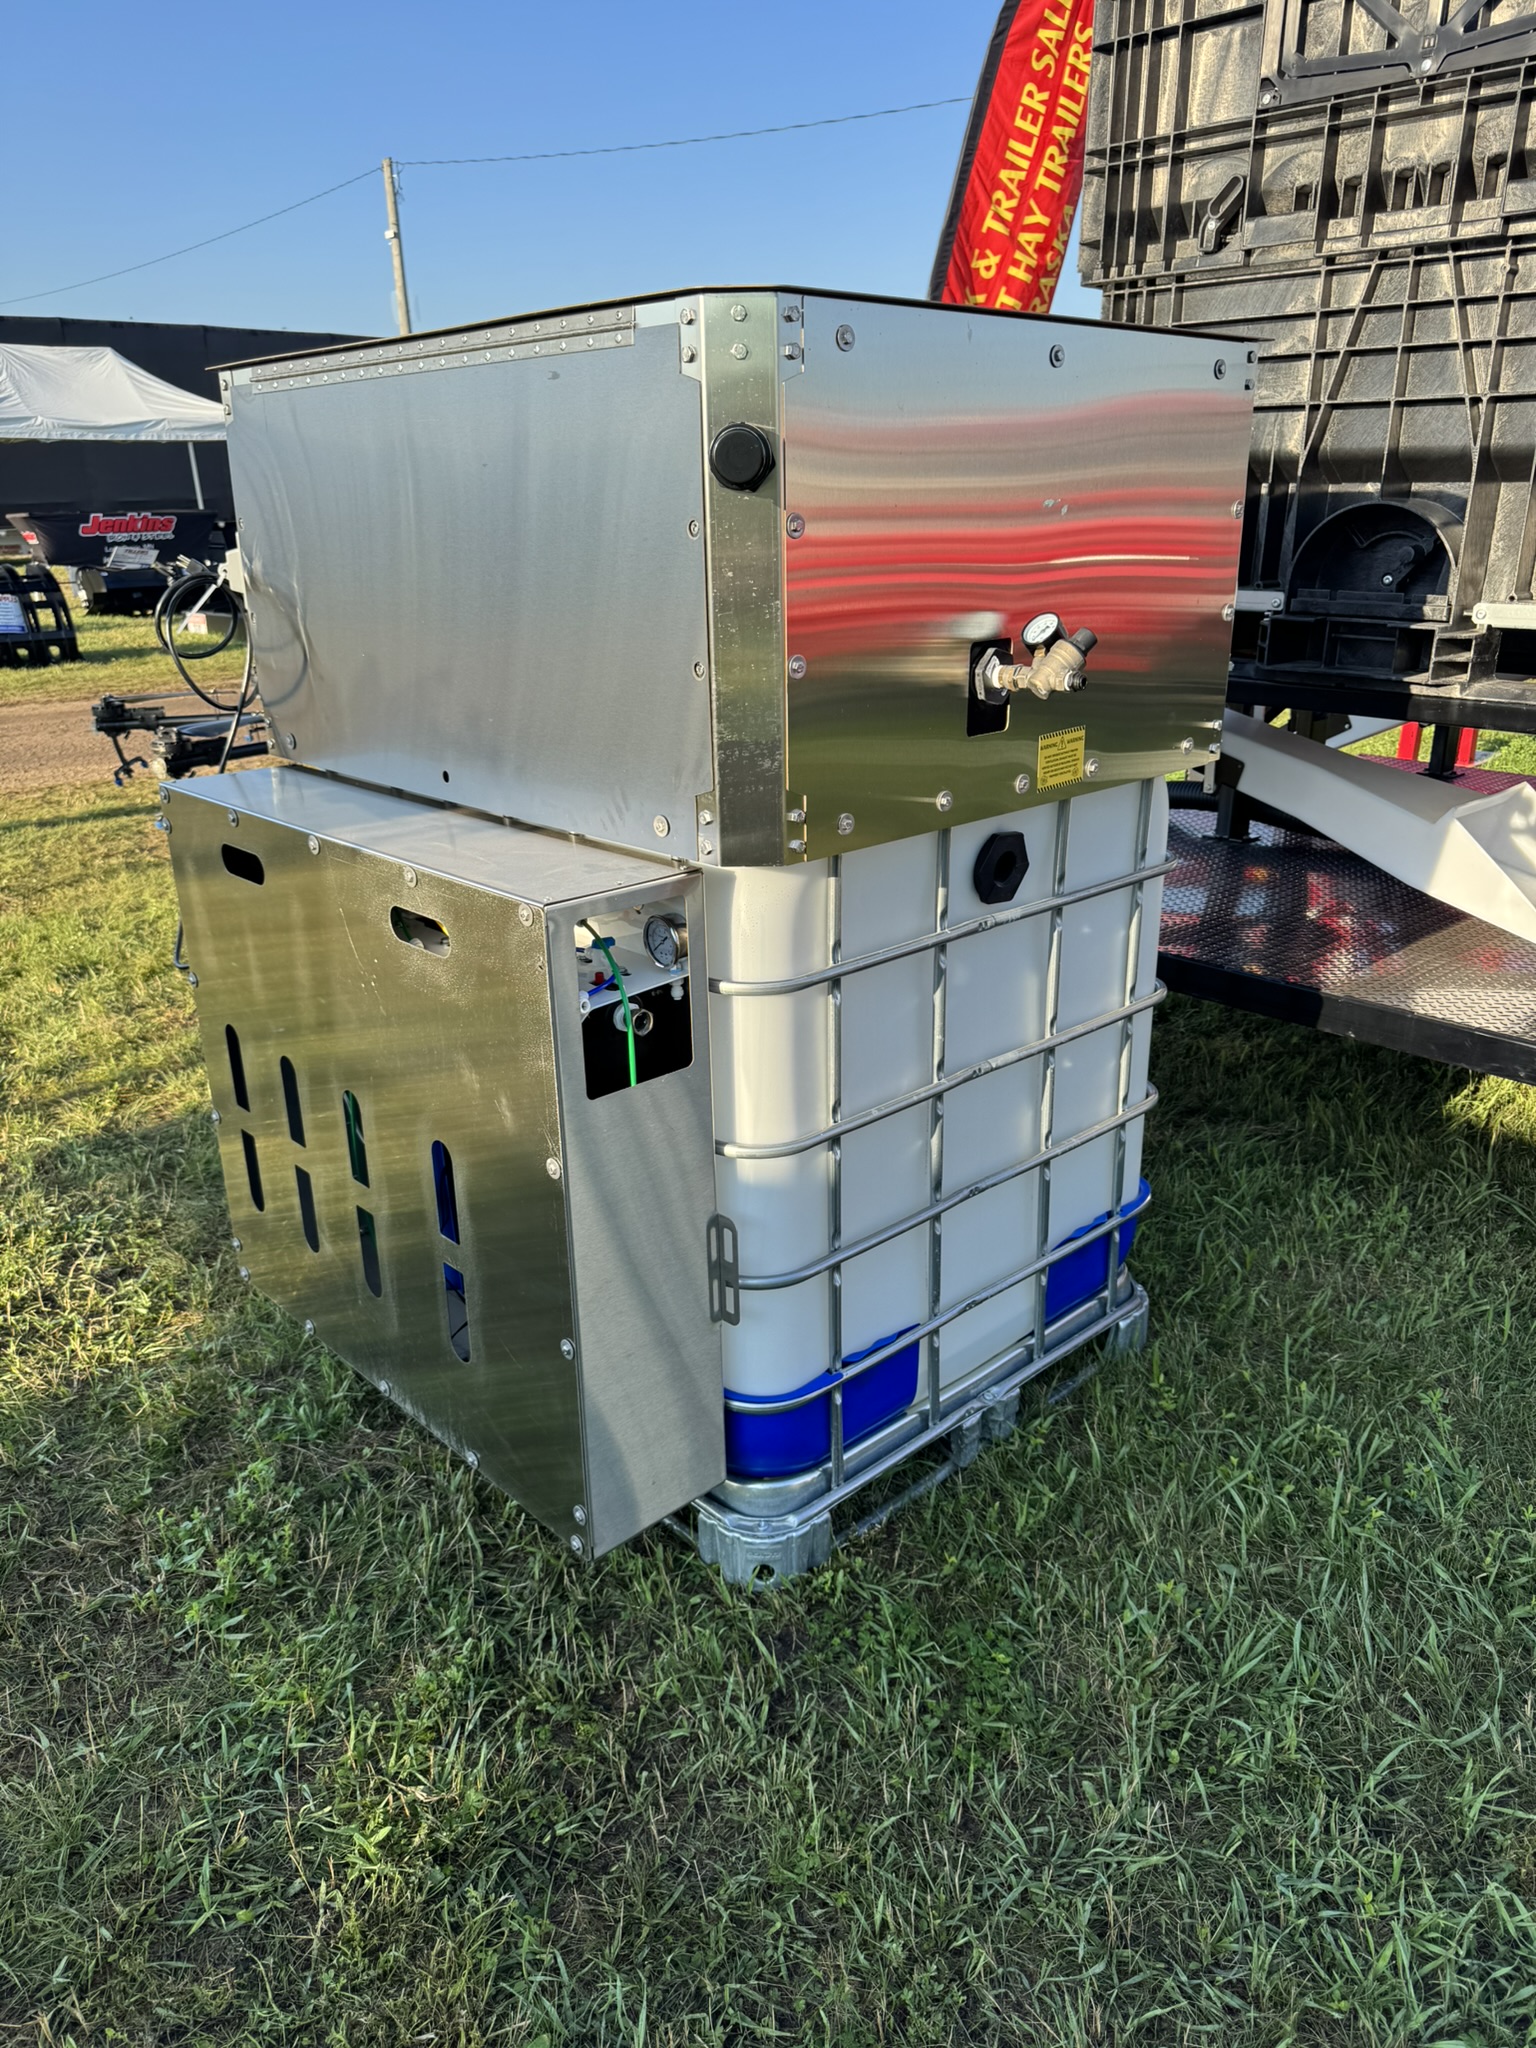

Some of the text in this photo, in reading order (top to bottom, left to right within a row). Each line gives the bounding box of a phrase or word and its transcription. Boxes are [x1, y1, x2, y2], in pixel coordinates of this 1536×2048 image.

[982, 82, 1050, 237] TRAILER
[1007, 198, 1051, 285] HAY
[1034, 21, 1093, 194] TRAILERS
[972, 248, 1002, 280] &
[79, 512, 177, 537] Jenkins
